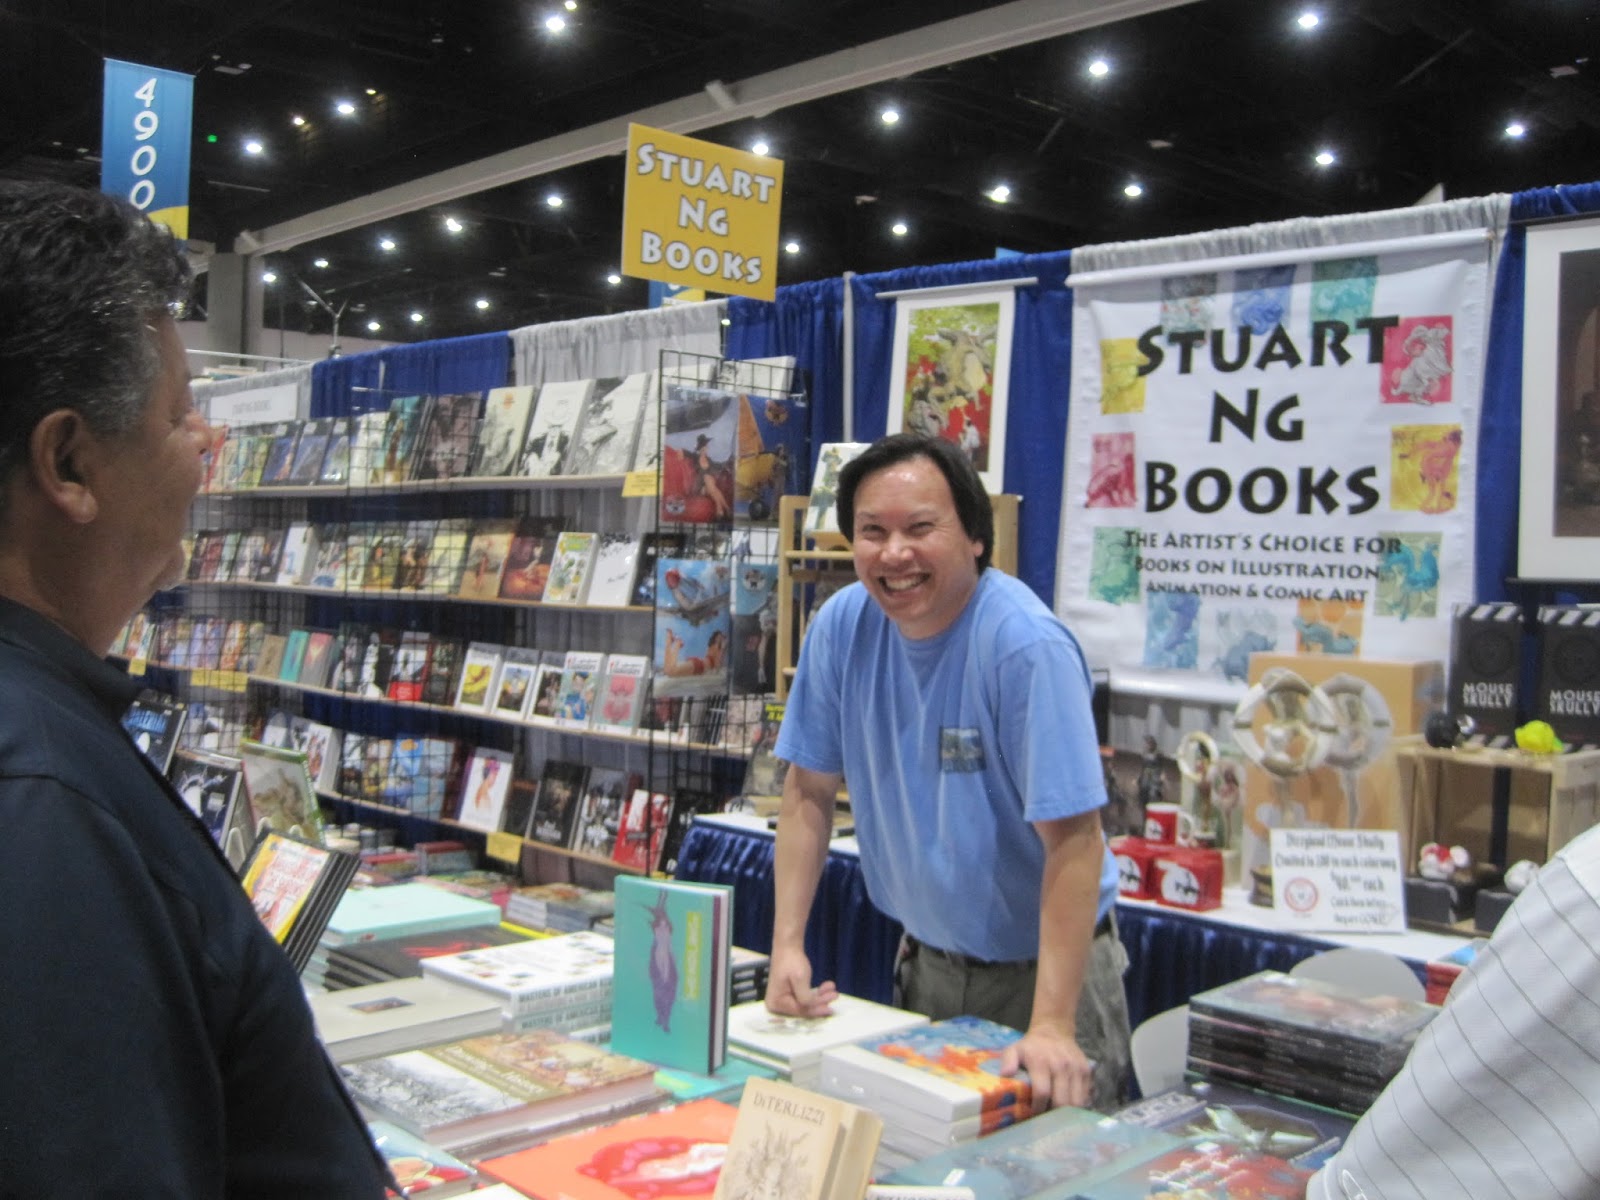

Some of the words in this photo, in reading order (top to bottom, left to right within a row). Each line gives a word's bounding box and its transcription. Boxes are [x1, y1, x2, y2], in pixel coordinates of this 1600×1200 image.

[129, 78, 159, 210] 4900
[637, 143, 776, 204] STUART
[678, 194, 729, 237] NG
[641, 230, 763, 284] BOOKS
[1135, 315, 1400, 379] STUART
[1209, 388, 1305, 444] NG
[1145, 461, 1381, 515] BOOKS
[1124, 530, 1158, 548] THE
[1163, 530, 1251, 550] ARTIST'S
[1259, 532, 1345, 553] CHOICE
[1354, 536, 1404, 555] FOR
[1135, 556, 1190, 573] BOOKS
[1196, 559, 1225, 574] ON
[1232, 558, 1381, 580] ILLUSTRATION
[1146, 580, 1241, 597] ANIMATION
[1246, 582, 1258, 598] &
[1263, 584, 1322, 601] COMIC
[1330, 586, 1370, 602] ART
[1463, 681, 1513, 695] MOUSE
[1550, 689, 1600, 702] MOUSE
